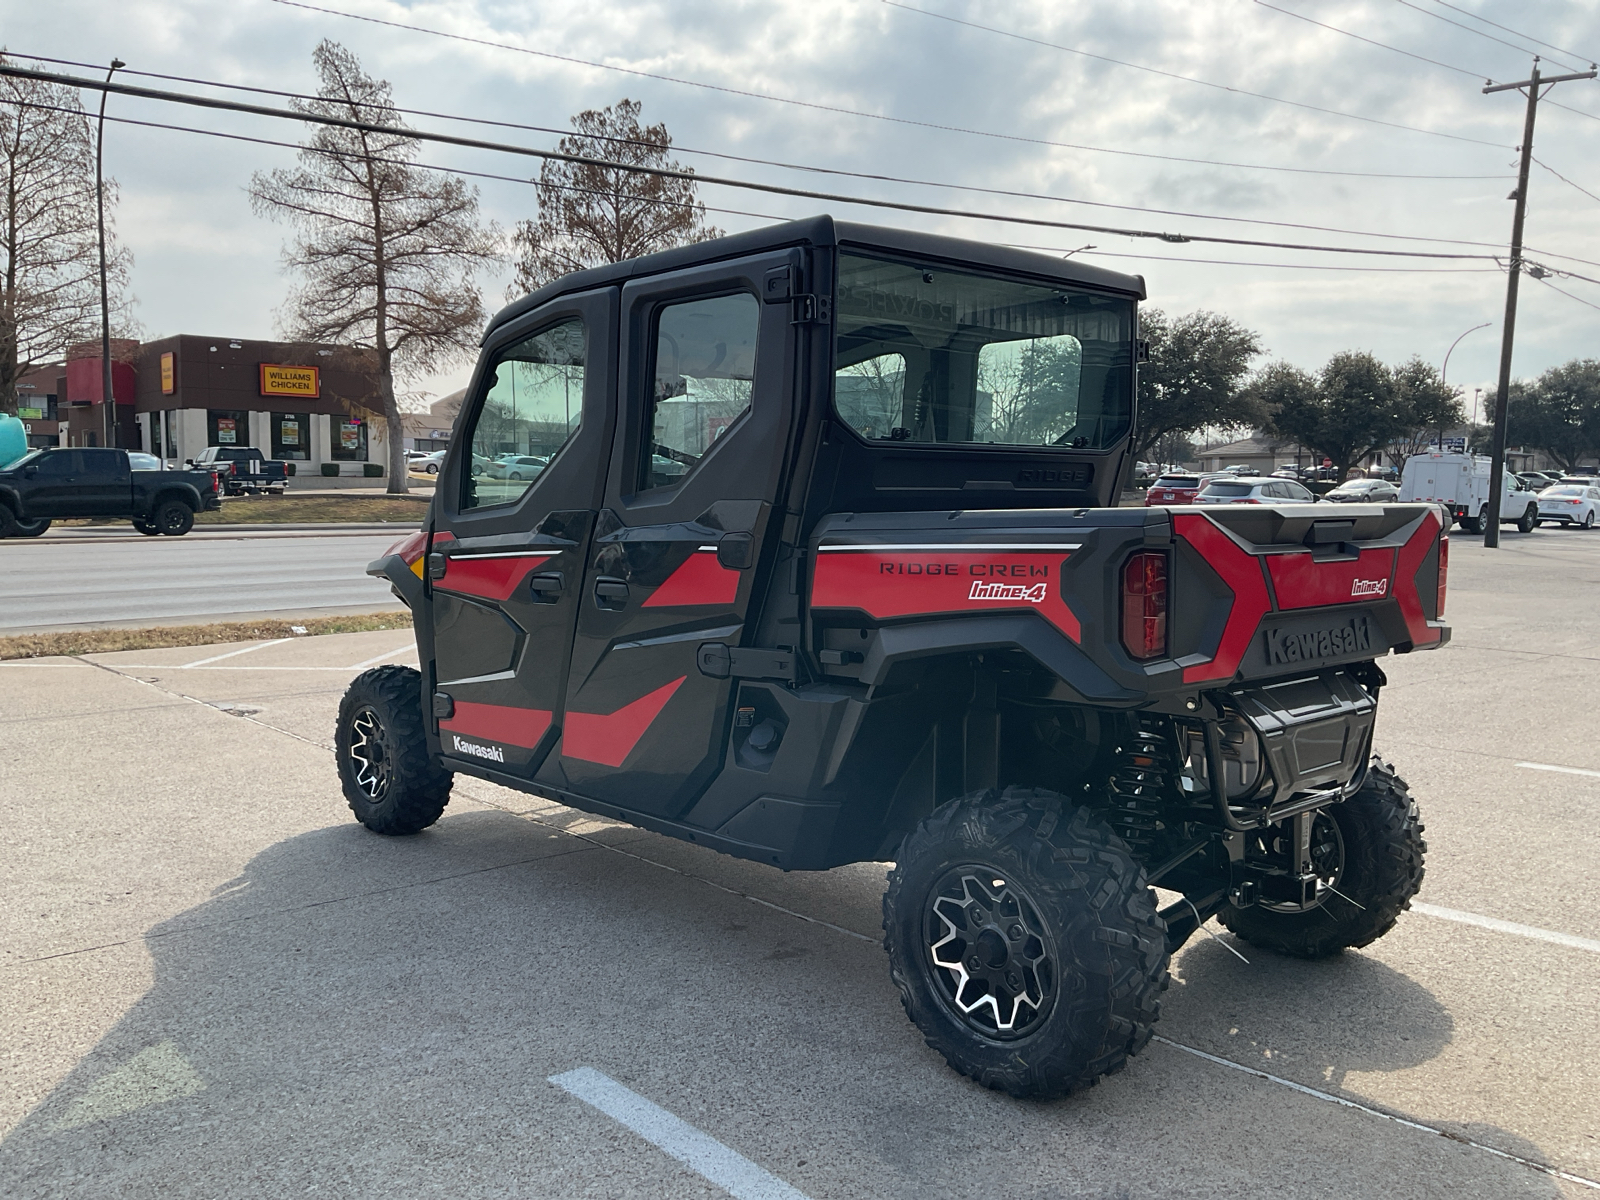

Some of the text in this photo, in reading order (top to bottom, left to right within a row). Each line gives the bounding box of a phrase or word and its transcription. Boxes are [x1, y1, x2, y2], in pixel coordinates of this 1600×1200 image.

[269, 372, 311, 381] WILLIAMS
[1019, 469, 1085, 482] RIDGE
[880, 563, 1048, 577] RIDGE CREW
[968, 580, 1047, 602] Inline-4
[1351, 579, 1387, 596] Inline-4
[1264, 616, 1371, 666] Kawasaki
[453, 735, 504, 763] Kawasaki
